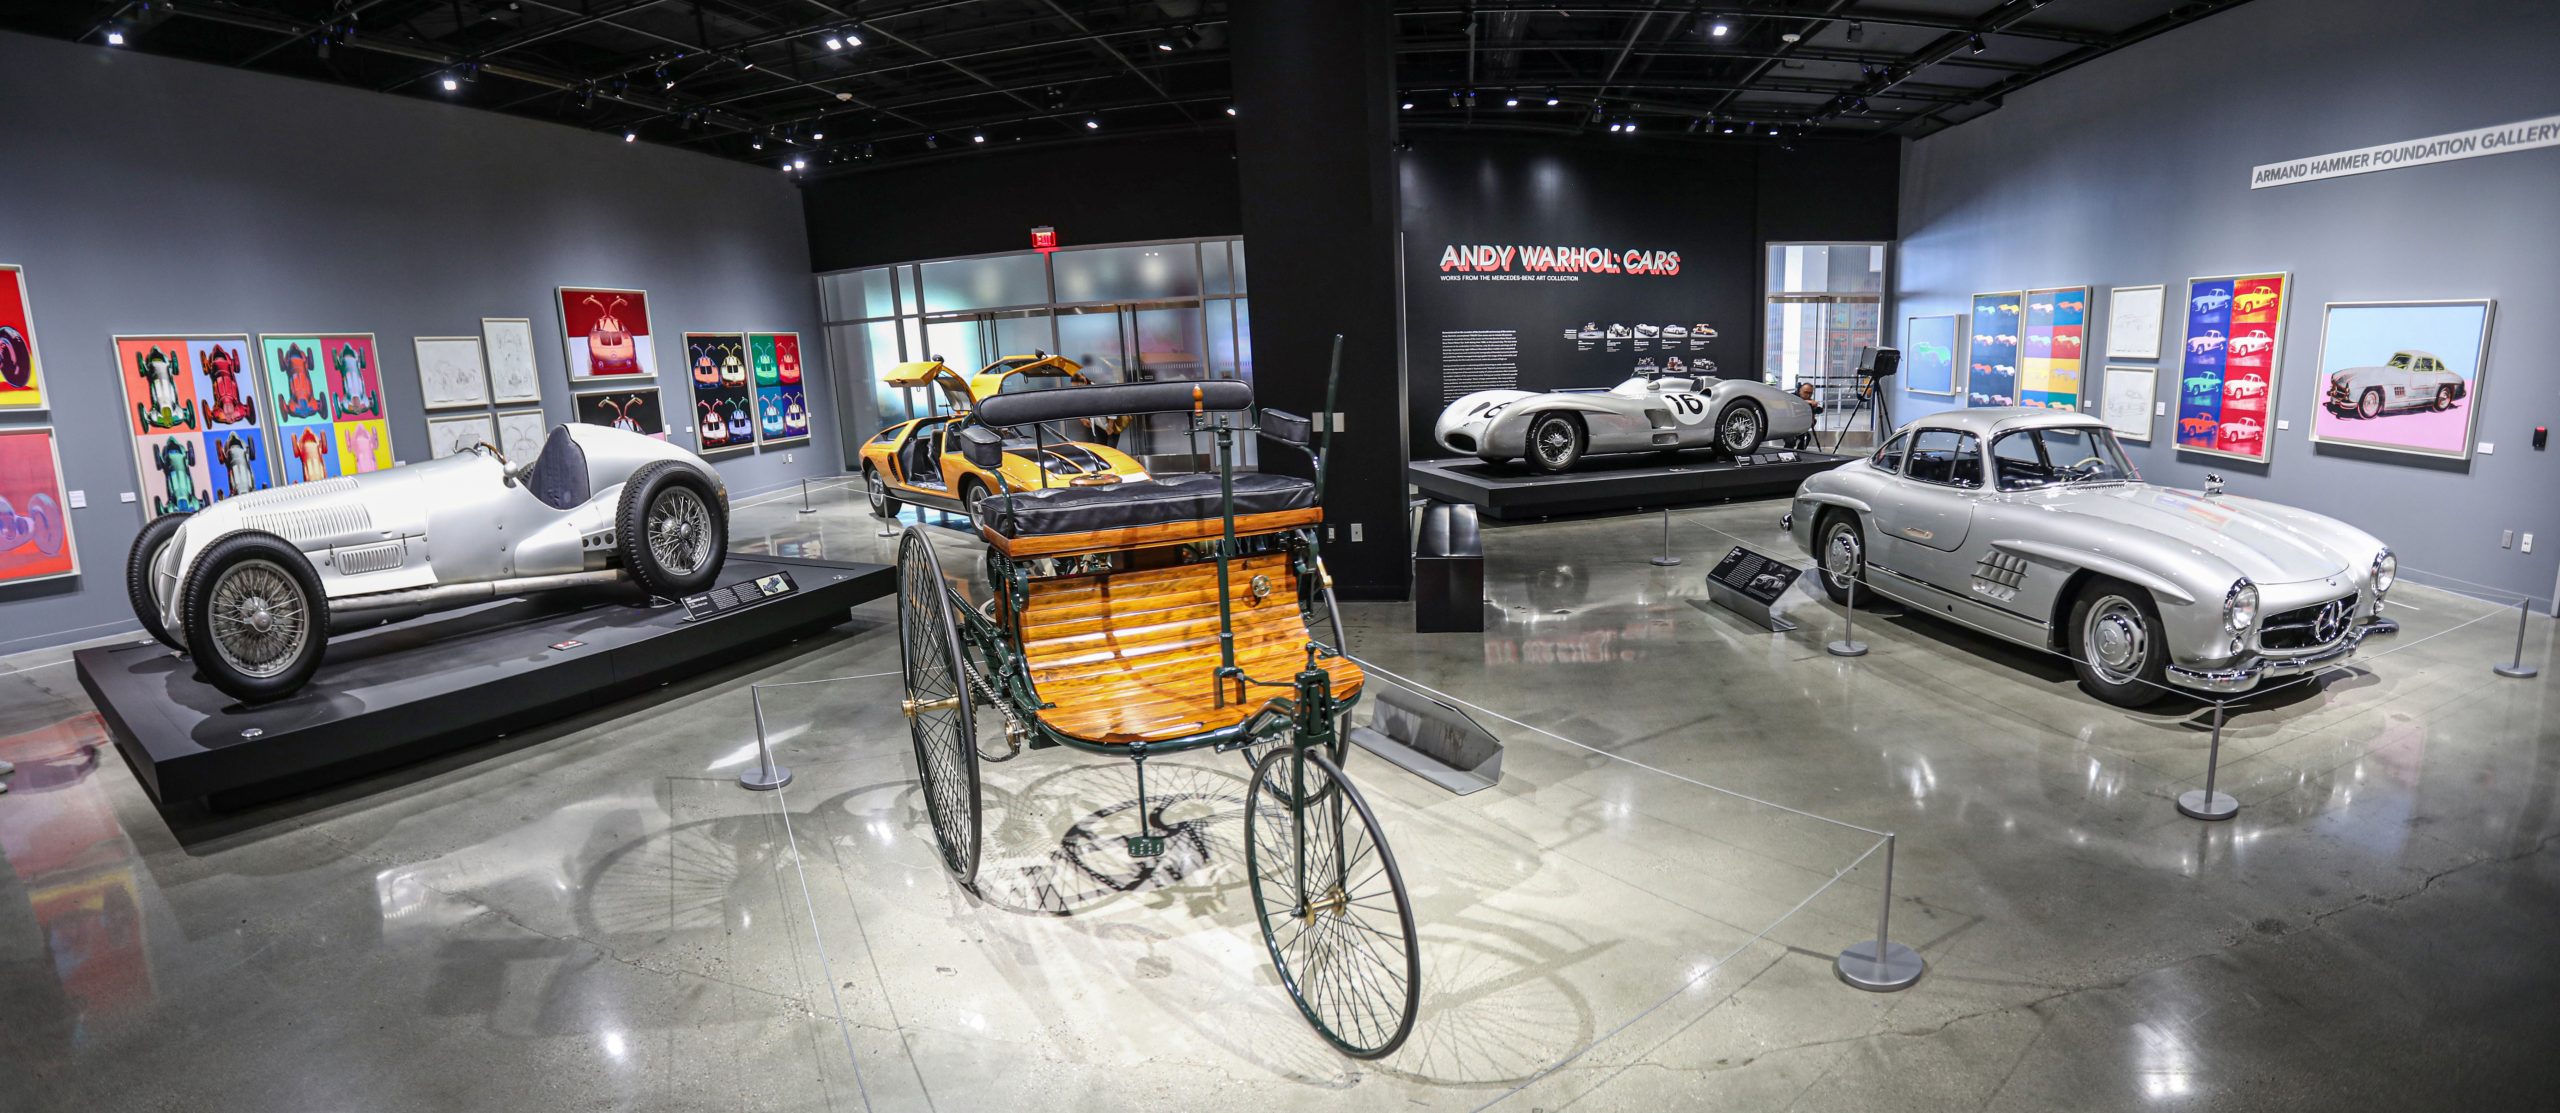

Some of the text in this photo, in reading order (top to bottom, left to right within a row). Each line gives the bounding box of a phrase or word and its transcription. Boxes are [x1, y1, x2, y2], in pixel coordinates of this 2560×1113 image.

[2254, 122, 2560, 184] ARMAND HAMMER FOUNDATION GALLERY
[1440, 245, 1681, 276] ANDY WARHOL: CARS
[1665, 394, 1704, 415] 16
